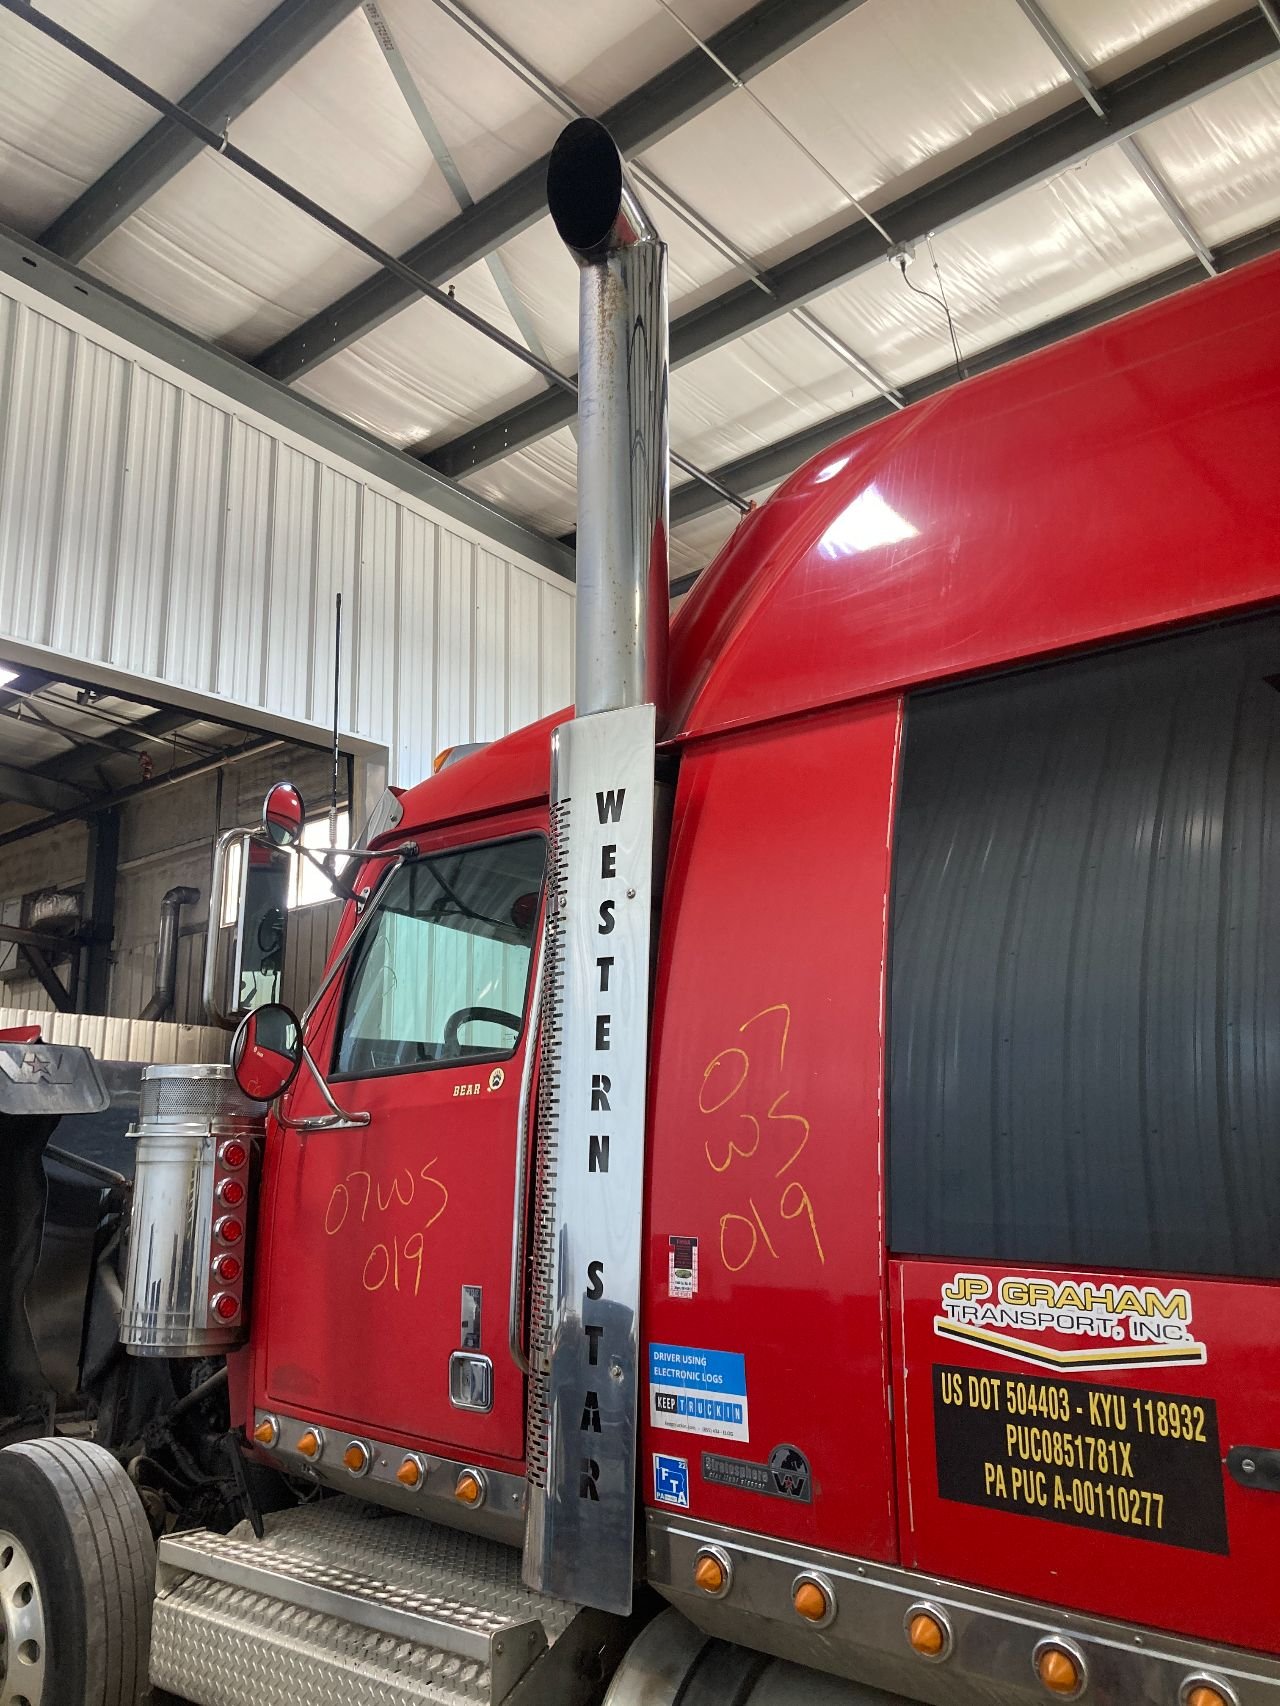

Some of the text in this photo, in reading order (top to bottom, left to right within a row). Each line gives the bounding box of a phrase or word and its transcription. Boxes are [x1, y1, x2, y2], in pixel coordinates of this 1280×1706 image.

[588, 789, 626, 1173] WESTERN
[453, 1083, 481, 1097] BEAR
[699, 1003, 790, 1114] 07
[720, 1182, 824, 1272] 019
[363, 1233, 424, 1296] 019
[945, 1278, 1187, 1320] JP GRAHAM
[945, 1304, 1190, 1342] TRANSPORT, INC.
[579, 1260, 604, 1501] STAR
[653, 1351, 707, 1366] DRIVER USING
[653, 1366, 723, 1384] ELECTRONIC LOGS
[941, 1372, 963, 1406] US
[968, 1376, 1000, 1411] DOT
[1006, 1381, 1070, 1422] 504403
[1088, 1391, 1127, 1431] KYU
[1132, 1398, 1207, 1443] 118932
[1006, 1424, 1134, 1478] PUC0851781X
[984, 1462, 1164, 1529] PA PUC A-00110277
